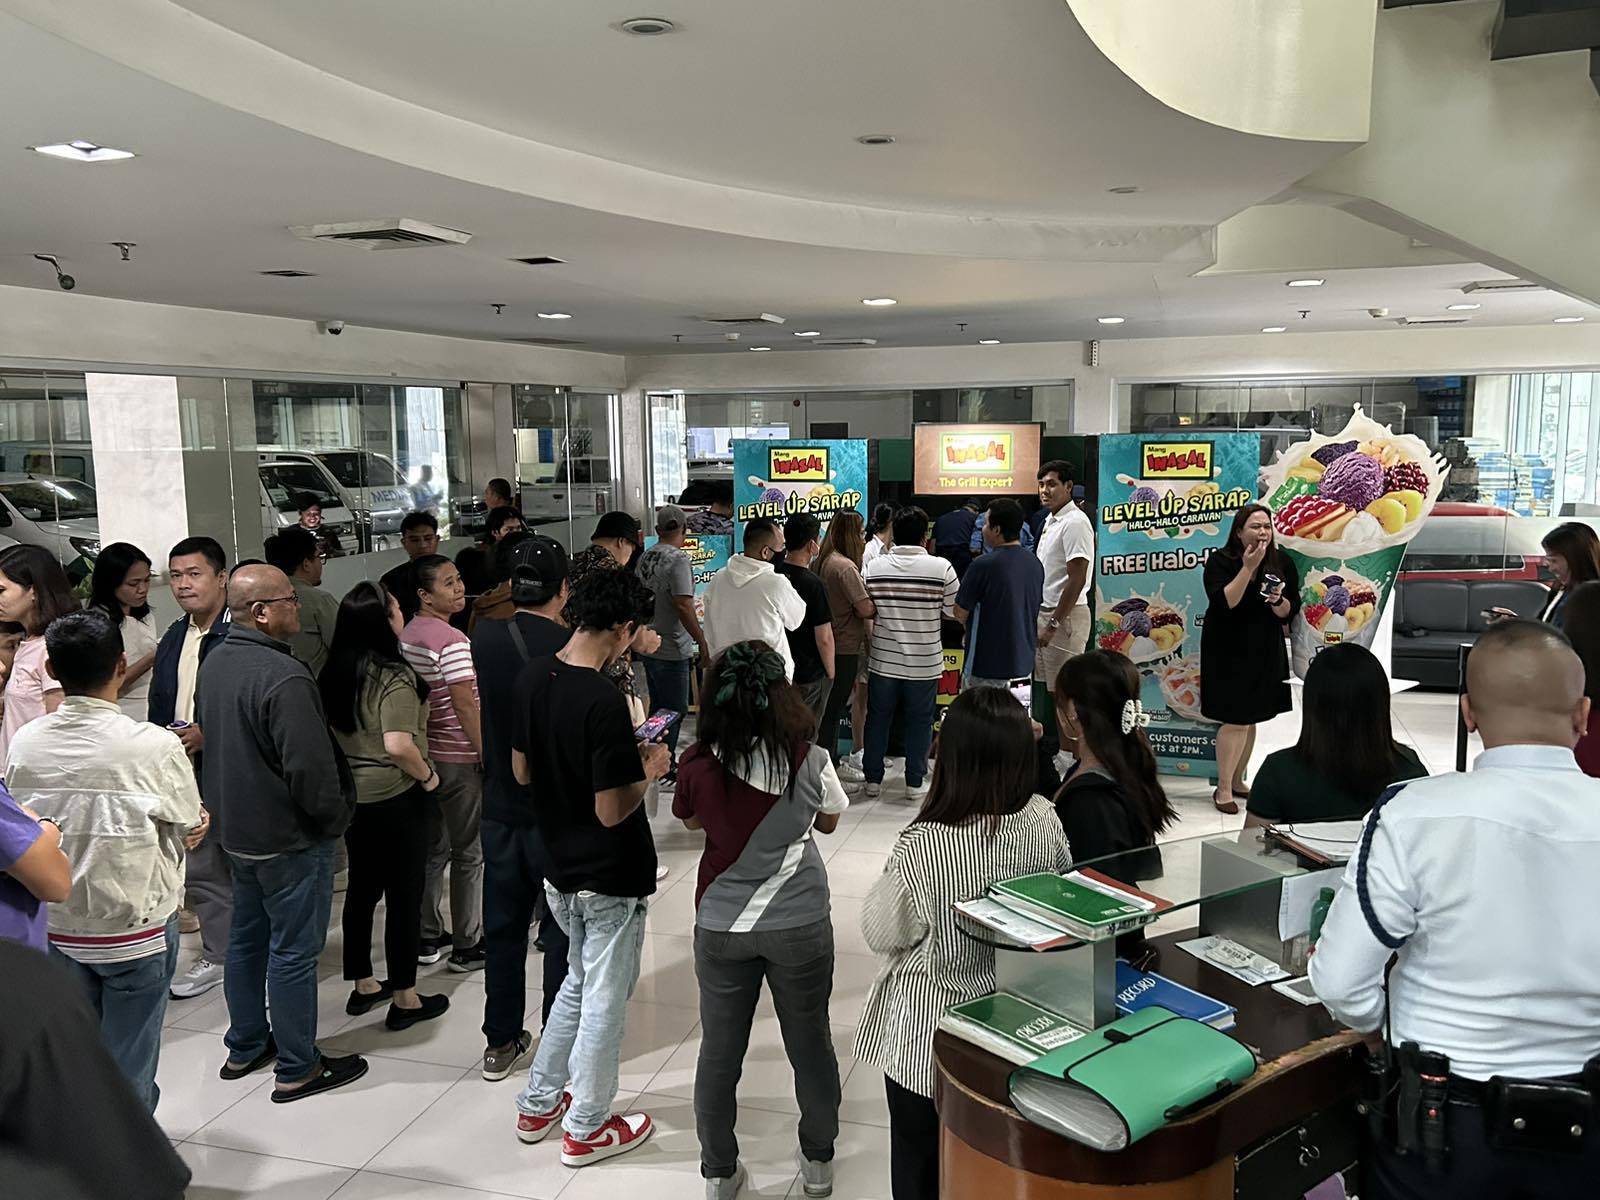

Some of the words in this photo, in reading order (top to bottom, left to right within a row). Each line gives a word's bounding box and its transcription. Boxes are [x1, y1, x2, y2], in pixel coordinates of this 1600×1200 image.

[946, 441, 1005, 464] IWASAL
[1148, 446, 1166, 454] Mang
[773, 454, 823, 475] IWASAL
[1147, 450, 1206, 472] IWASAL
[940, 477, 956, 487] The
[958, 477, 978, 487] Grill
[980, 477, 1013, 489] Expert
[739, 501, 781, 520] LEVEL
[786, 490, 806, 514] UP
[809, 492, 861, 512] SARAP
[1104, 502, 1154, 521] LEVEL
[1160, 489, 1184, 515] UP
[1189, 491, 1250, 513] SARAP
[1128, 516, 1179, 530] HALO-HALO
[1181, 512, 1221, 525] CARAVAN
[1102, 553, 1146, 574] FREE
[943, 654, 957, 664] ng
[839, 717, 852, 728] nly
[1149, 732, 1208, 746] customers
[1151, 743, 1166, 752] rts
[1168, 744, 1180, 753] at
[1182, 745, 1204, 755] 2PM.
[1118, 976, 1156, 1004] RECORD
